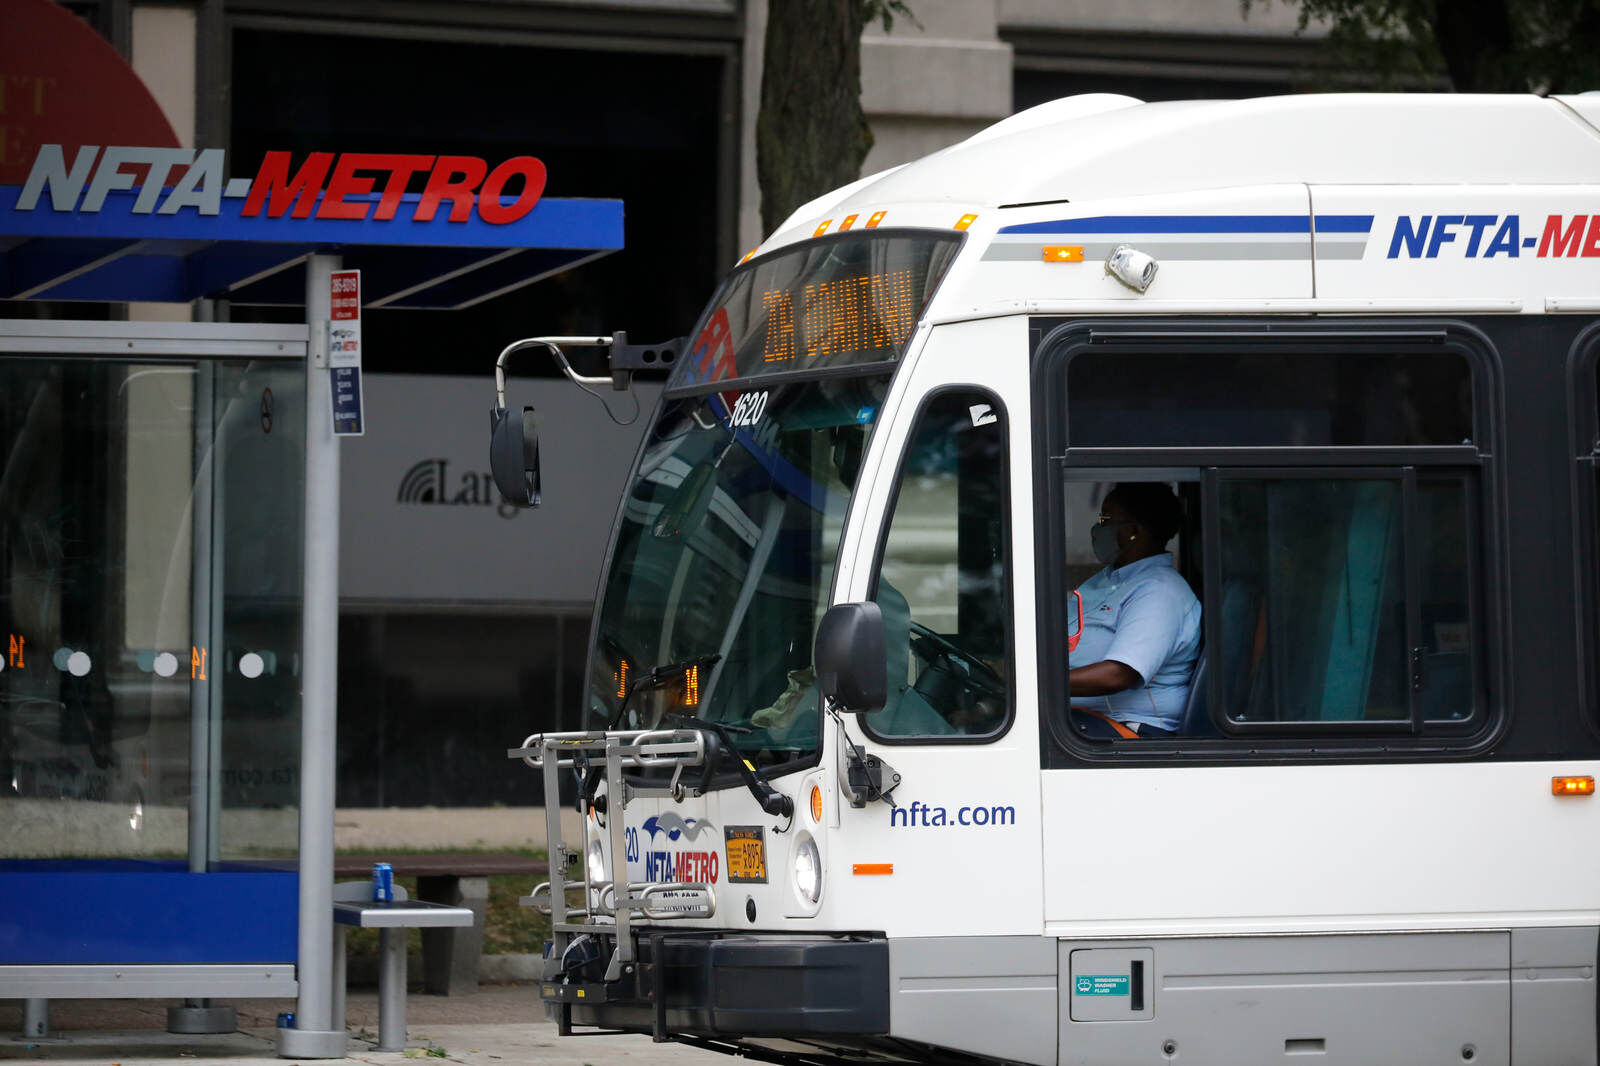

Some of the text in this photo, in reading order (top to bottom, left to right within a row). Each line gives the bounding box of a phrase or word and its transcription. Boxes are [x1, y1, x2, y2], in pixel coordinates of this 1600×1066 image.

[16, 144, 547, 225] NFTA-METRO
[728, 391, 768, 428] 1620
[437, 460, 519, 519] Lar
[685, 665, 698, 705] 14
[891, 802, 1015, 827] nfta.com
[624, 826, 639, 863] 20
[645, 851, 719, 884] NFTA-METRO
